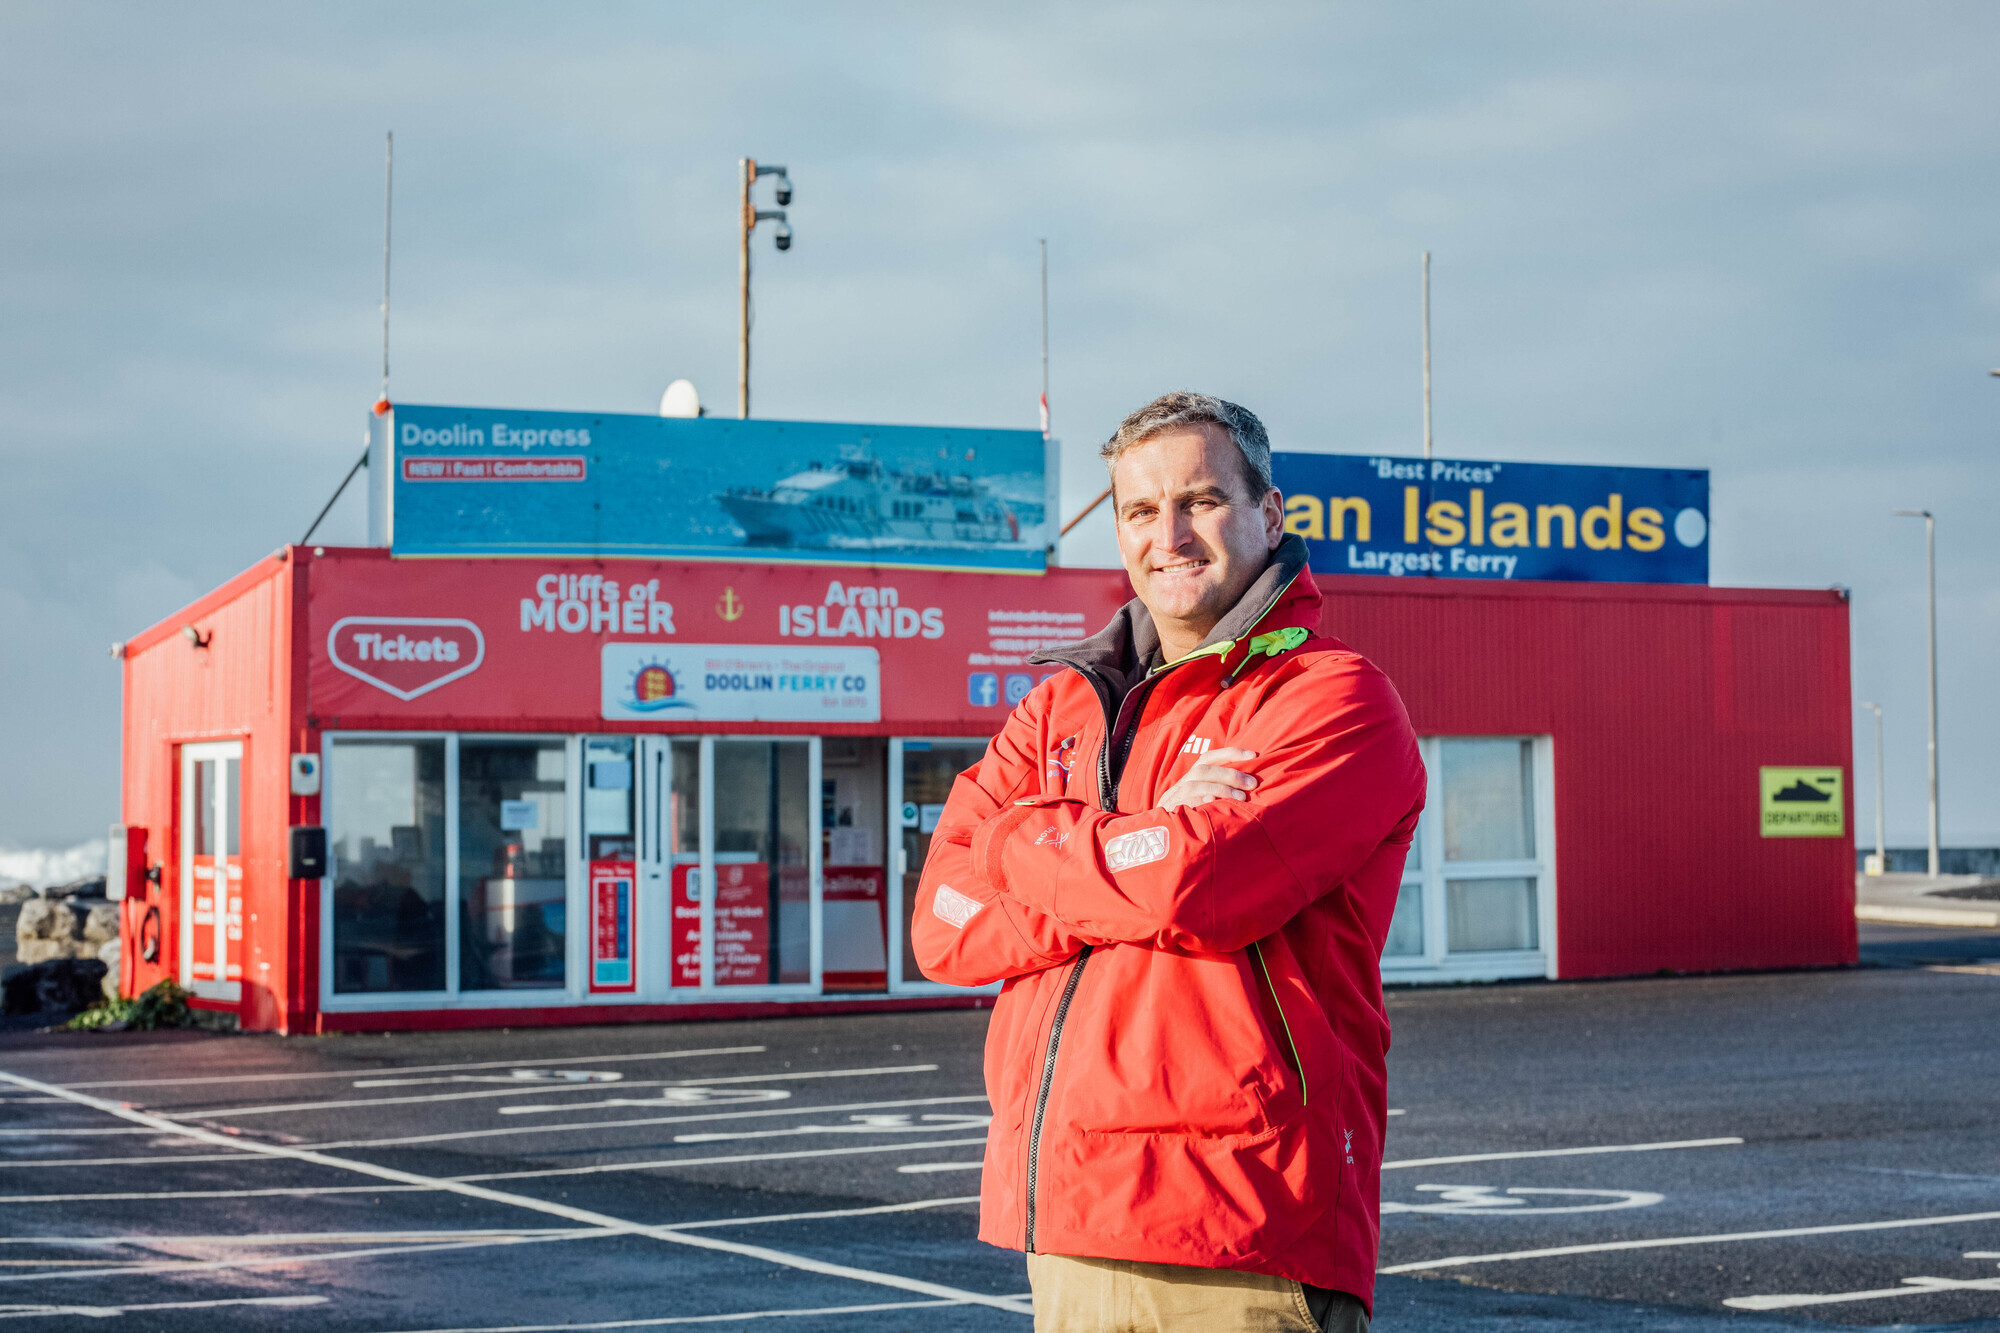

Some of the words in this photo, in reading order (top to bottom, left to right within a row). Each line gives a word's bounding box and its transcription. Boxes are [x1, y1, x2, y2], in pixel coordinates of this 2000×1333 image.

[402, 424, 484, 446] Doolin
[492, 424, 591, 451] Express
[409, 461, 444, 476] NEW
[453, 462, 484, 476] Fast
[493, 462, 580, 477] Comfortable
[1284, 494, 1371, 541] an
[1404, 486, 1666, 552] Islands
[1348, 545, 1442, 576] Largest
[1451, 549, 1518, 579] Ferry
[536, 574, 620, 601] Cliffs
[629, 579, 660, 601] of
[824, 581, 898, 608] Aran
[520, 599, 676, 634] MOHER
[779, 604, 945, 639] ISLANDS
[353, 633, 460, 662] Tickets
[705, 674, 773, 690] DOOLIN
[778, 675, 838, 691] FERRY
[842, 675, 866, 691] CO
[1178, 734, 1211, 757] ill
[1034, 825, 1056, 845] XPLORE
